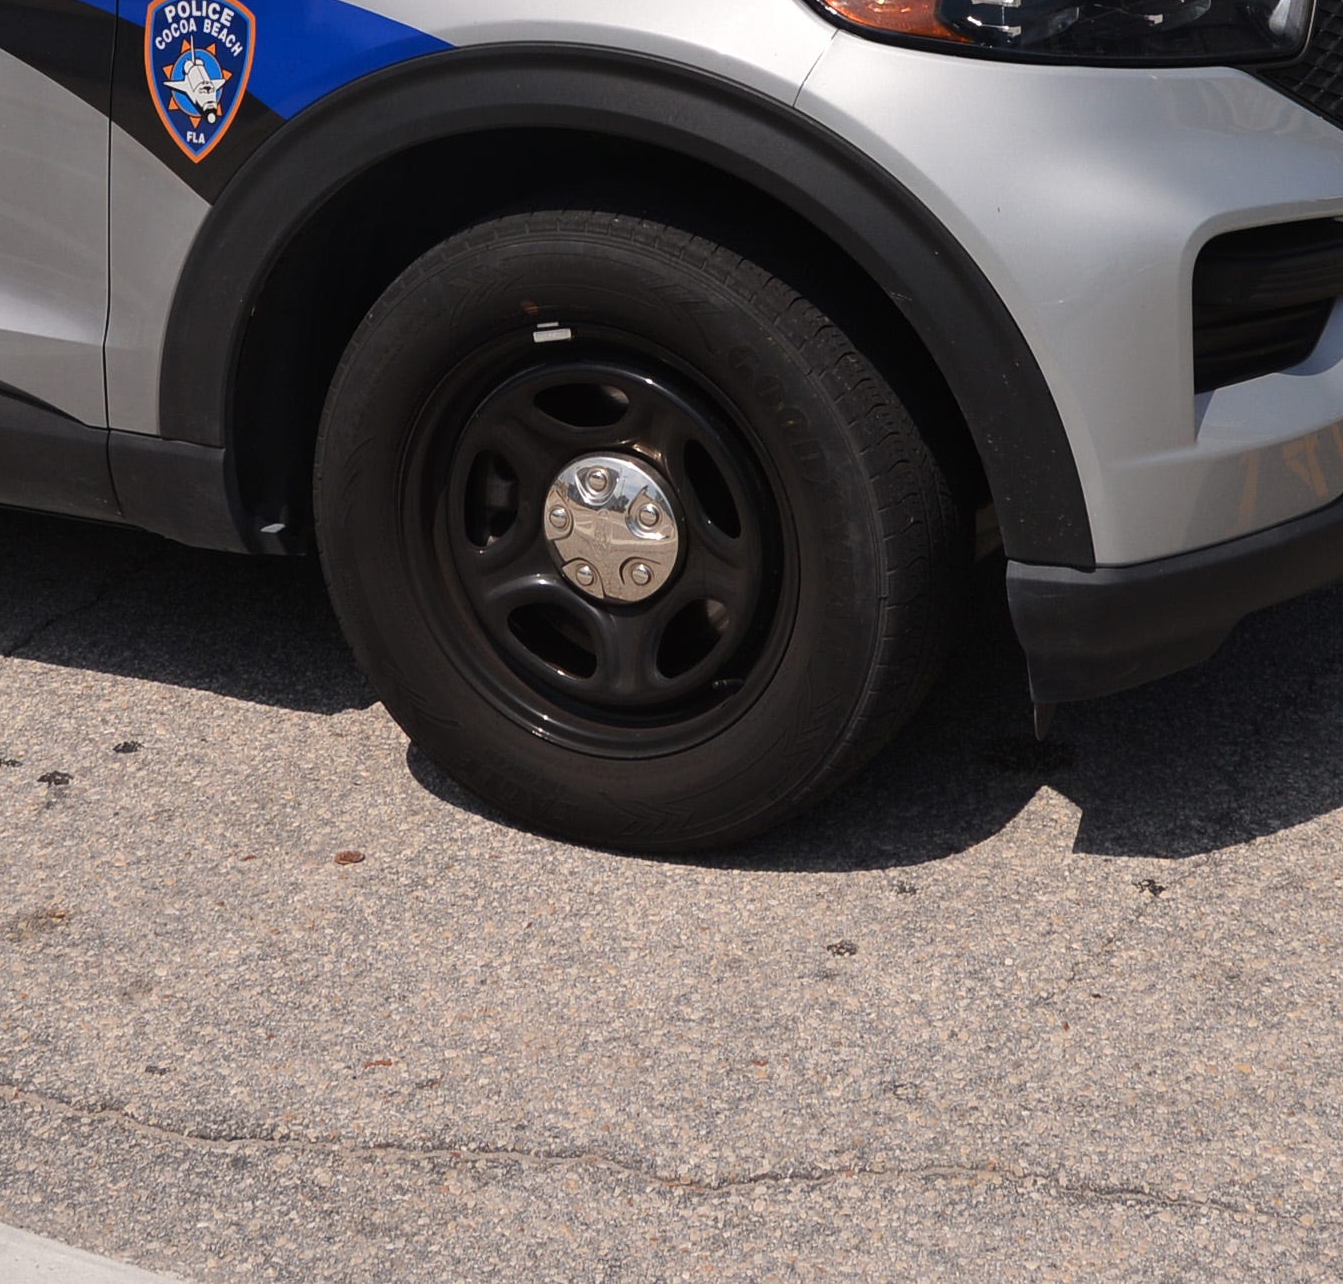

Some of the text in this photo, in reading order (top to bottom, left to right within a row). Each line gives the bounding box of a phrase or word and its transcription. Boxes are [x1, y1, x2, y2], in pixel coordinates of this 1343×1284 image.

[164, 0, 235, 27] POLICE
[155, 18, 243, 57] COCOA BEACH
[186, 131, 205, 144] FLA
